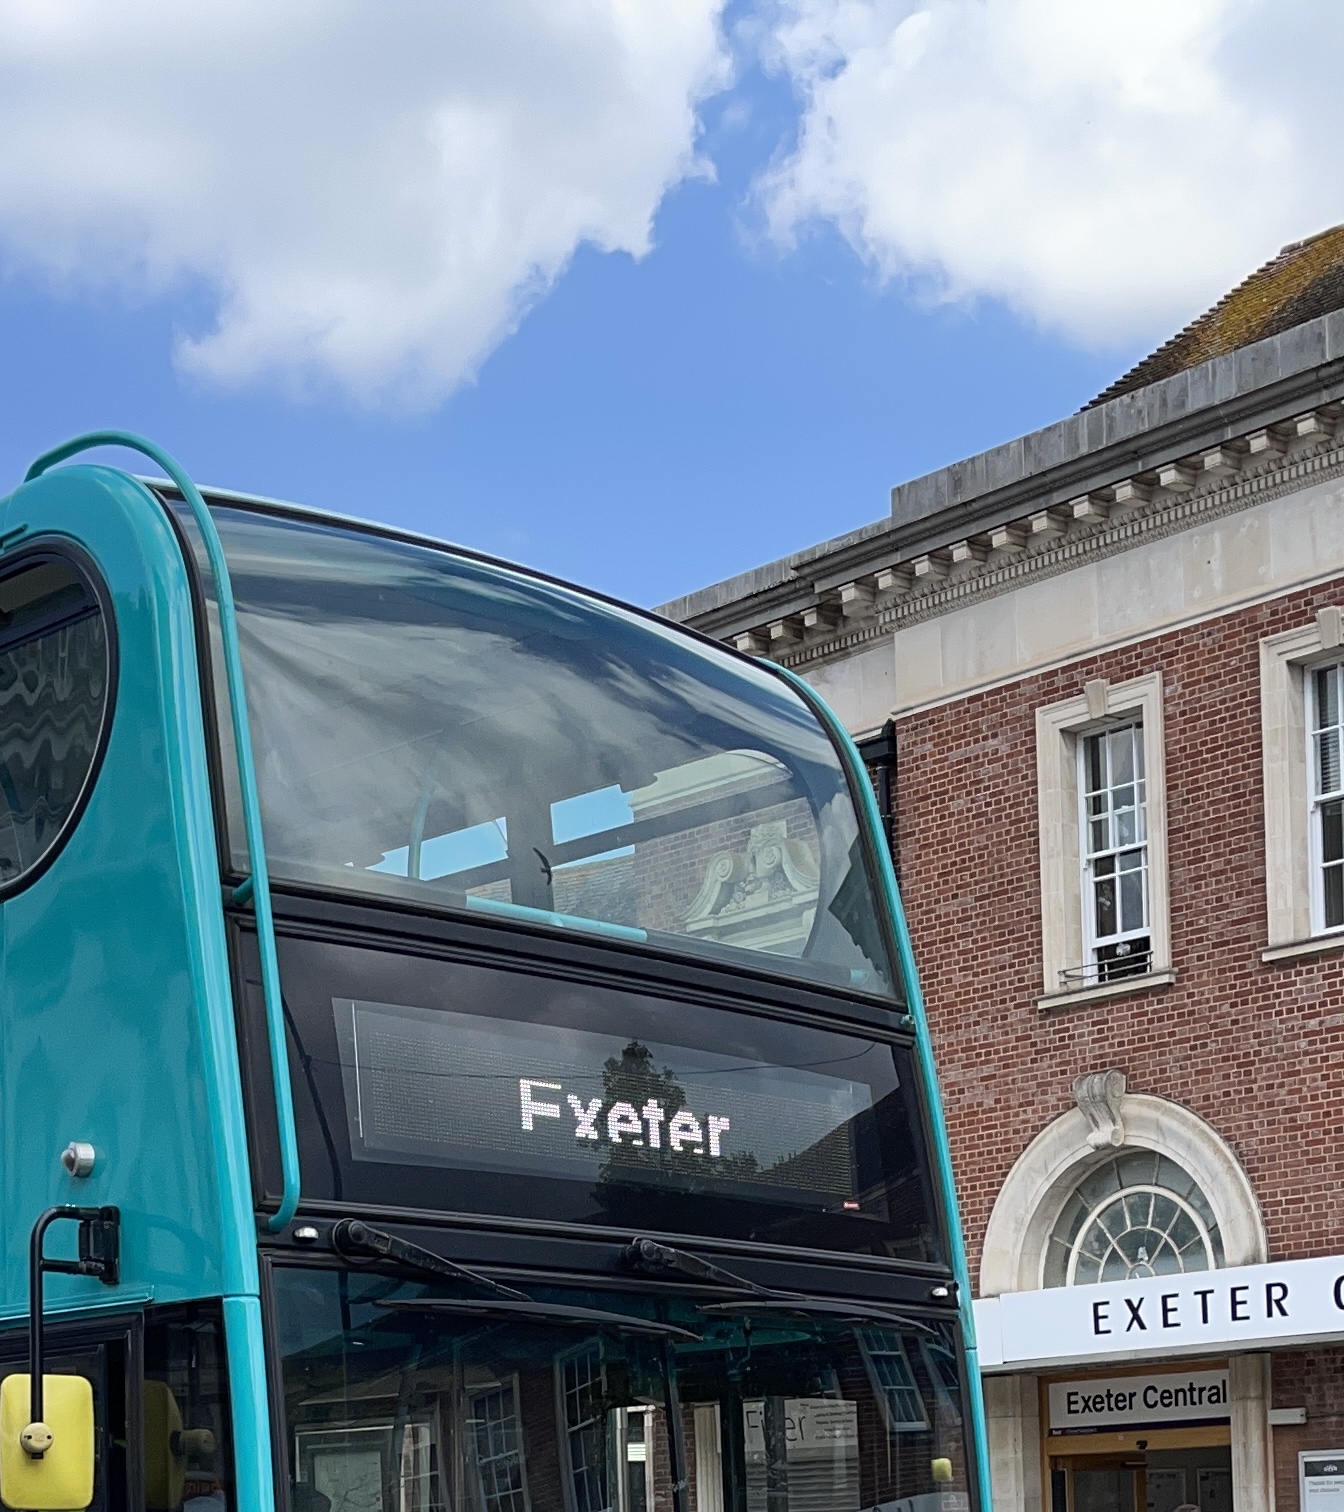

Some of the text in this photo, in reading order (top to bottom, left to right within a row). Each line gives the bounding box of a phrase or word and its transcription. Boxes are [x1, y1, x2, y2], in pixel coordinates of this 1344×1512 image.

[1093, 1281, 1290, 1336] EXETER
[1066, 1379, 1227, 1415] Exeter Central
